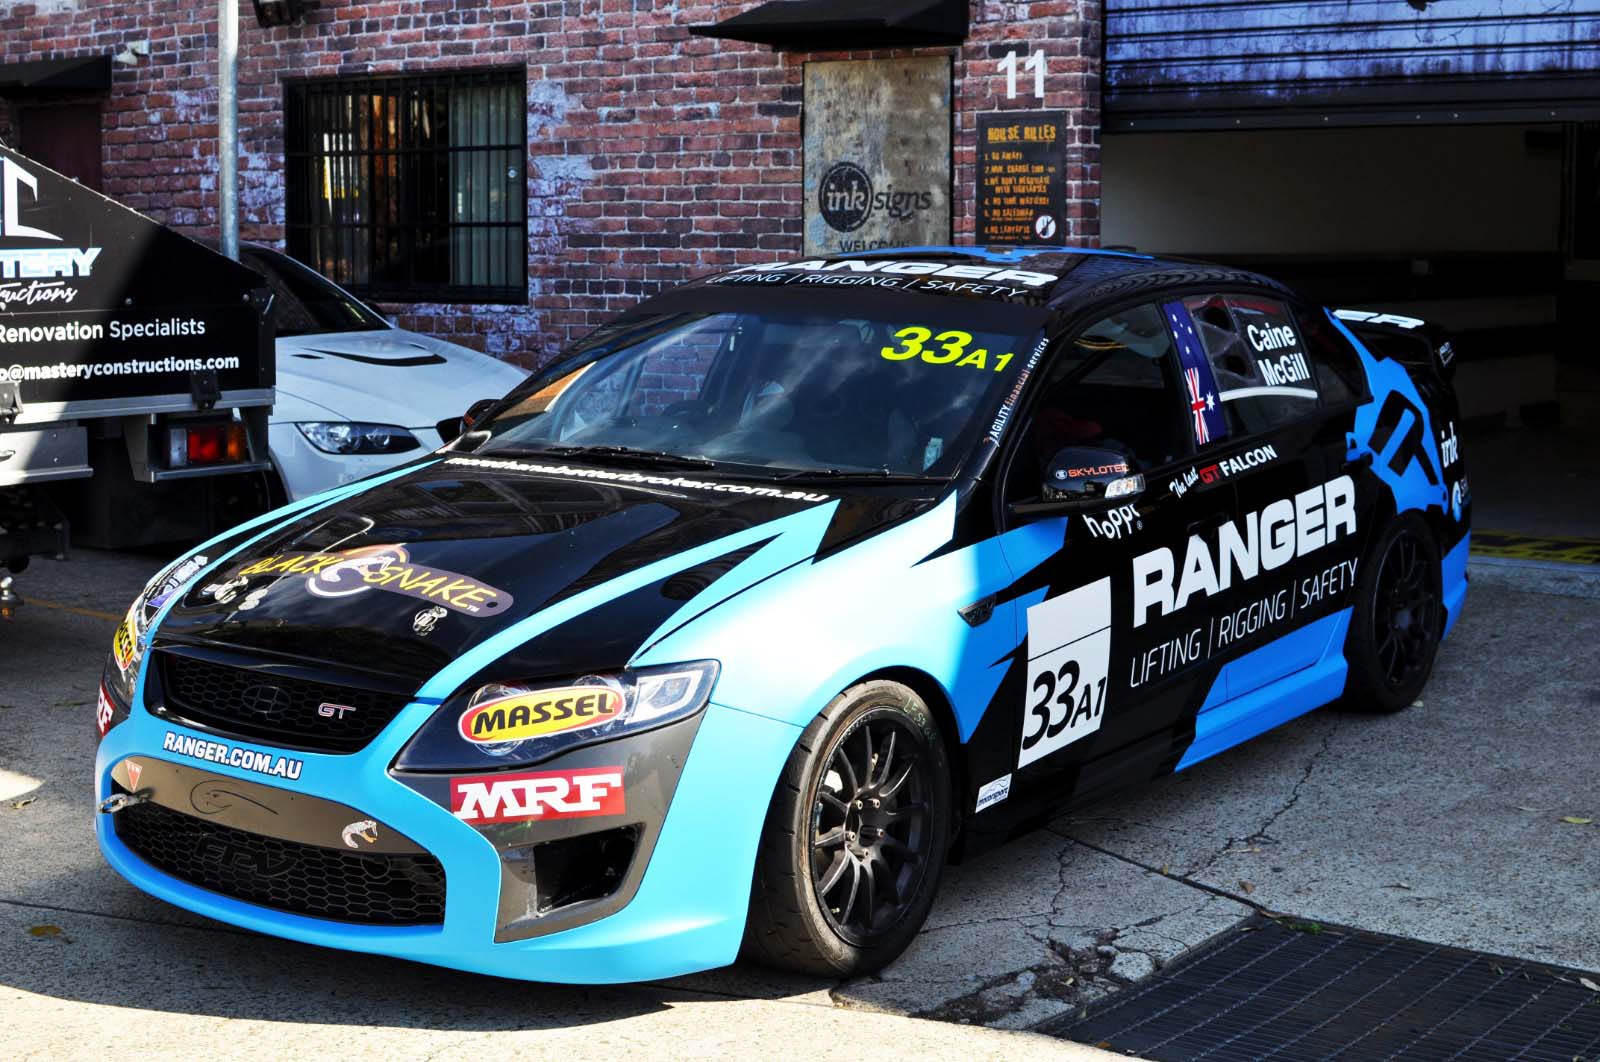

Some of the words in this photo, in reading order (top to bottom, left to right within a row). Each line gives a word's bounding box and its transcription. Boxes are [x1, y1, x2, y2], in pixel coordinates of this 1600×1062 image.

[997, 50, 1047, 99] 11
[1024, 124, 1056, 141] RULES
[827, 180, 866, 211] ink
[873, 184, 932, 218] signs
[705, 273, 787, 285] LIFTING
[800, 274, 904, 289] RIGGING
[920, 280, 1029, 298] SAFETY
[727, 260, 1058, 287] RANGER
[109, 317, 206, 341] Specialists
[1247, 322, 1296, 352] Caine
[1027, 337, 1050, 369] services
[1257, 352, 1311, 386] McGill
[1199, 464, 1220, 484] GT
[1219, 444, 1278, 477] FALCON
[1132, 475, 1356, 629] RANGER
[239, 555, 344, 576] BLACK
[364, 566, 497, 609] SNAKE
[1130, 628, 1202, 688] LIFTING
[1218, 589, 1286, 648] RIGGING
[1300, 557, 1358, 609] SAFETY
[318, 702, 357, 720] GT
[473, 693, 615, 735] MASSEL
[163, 732, 303, 780] RANGER.COM.AU
[453, 773, 622, 820] MRF
